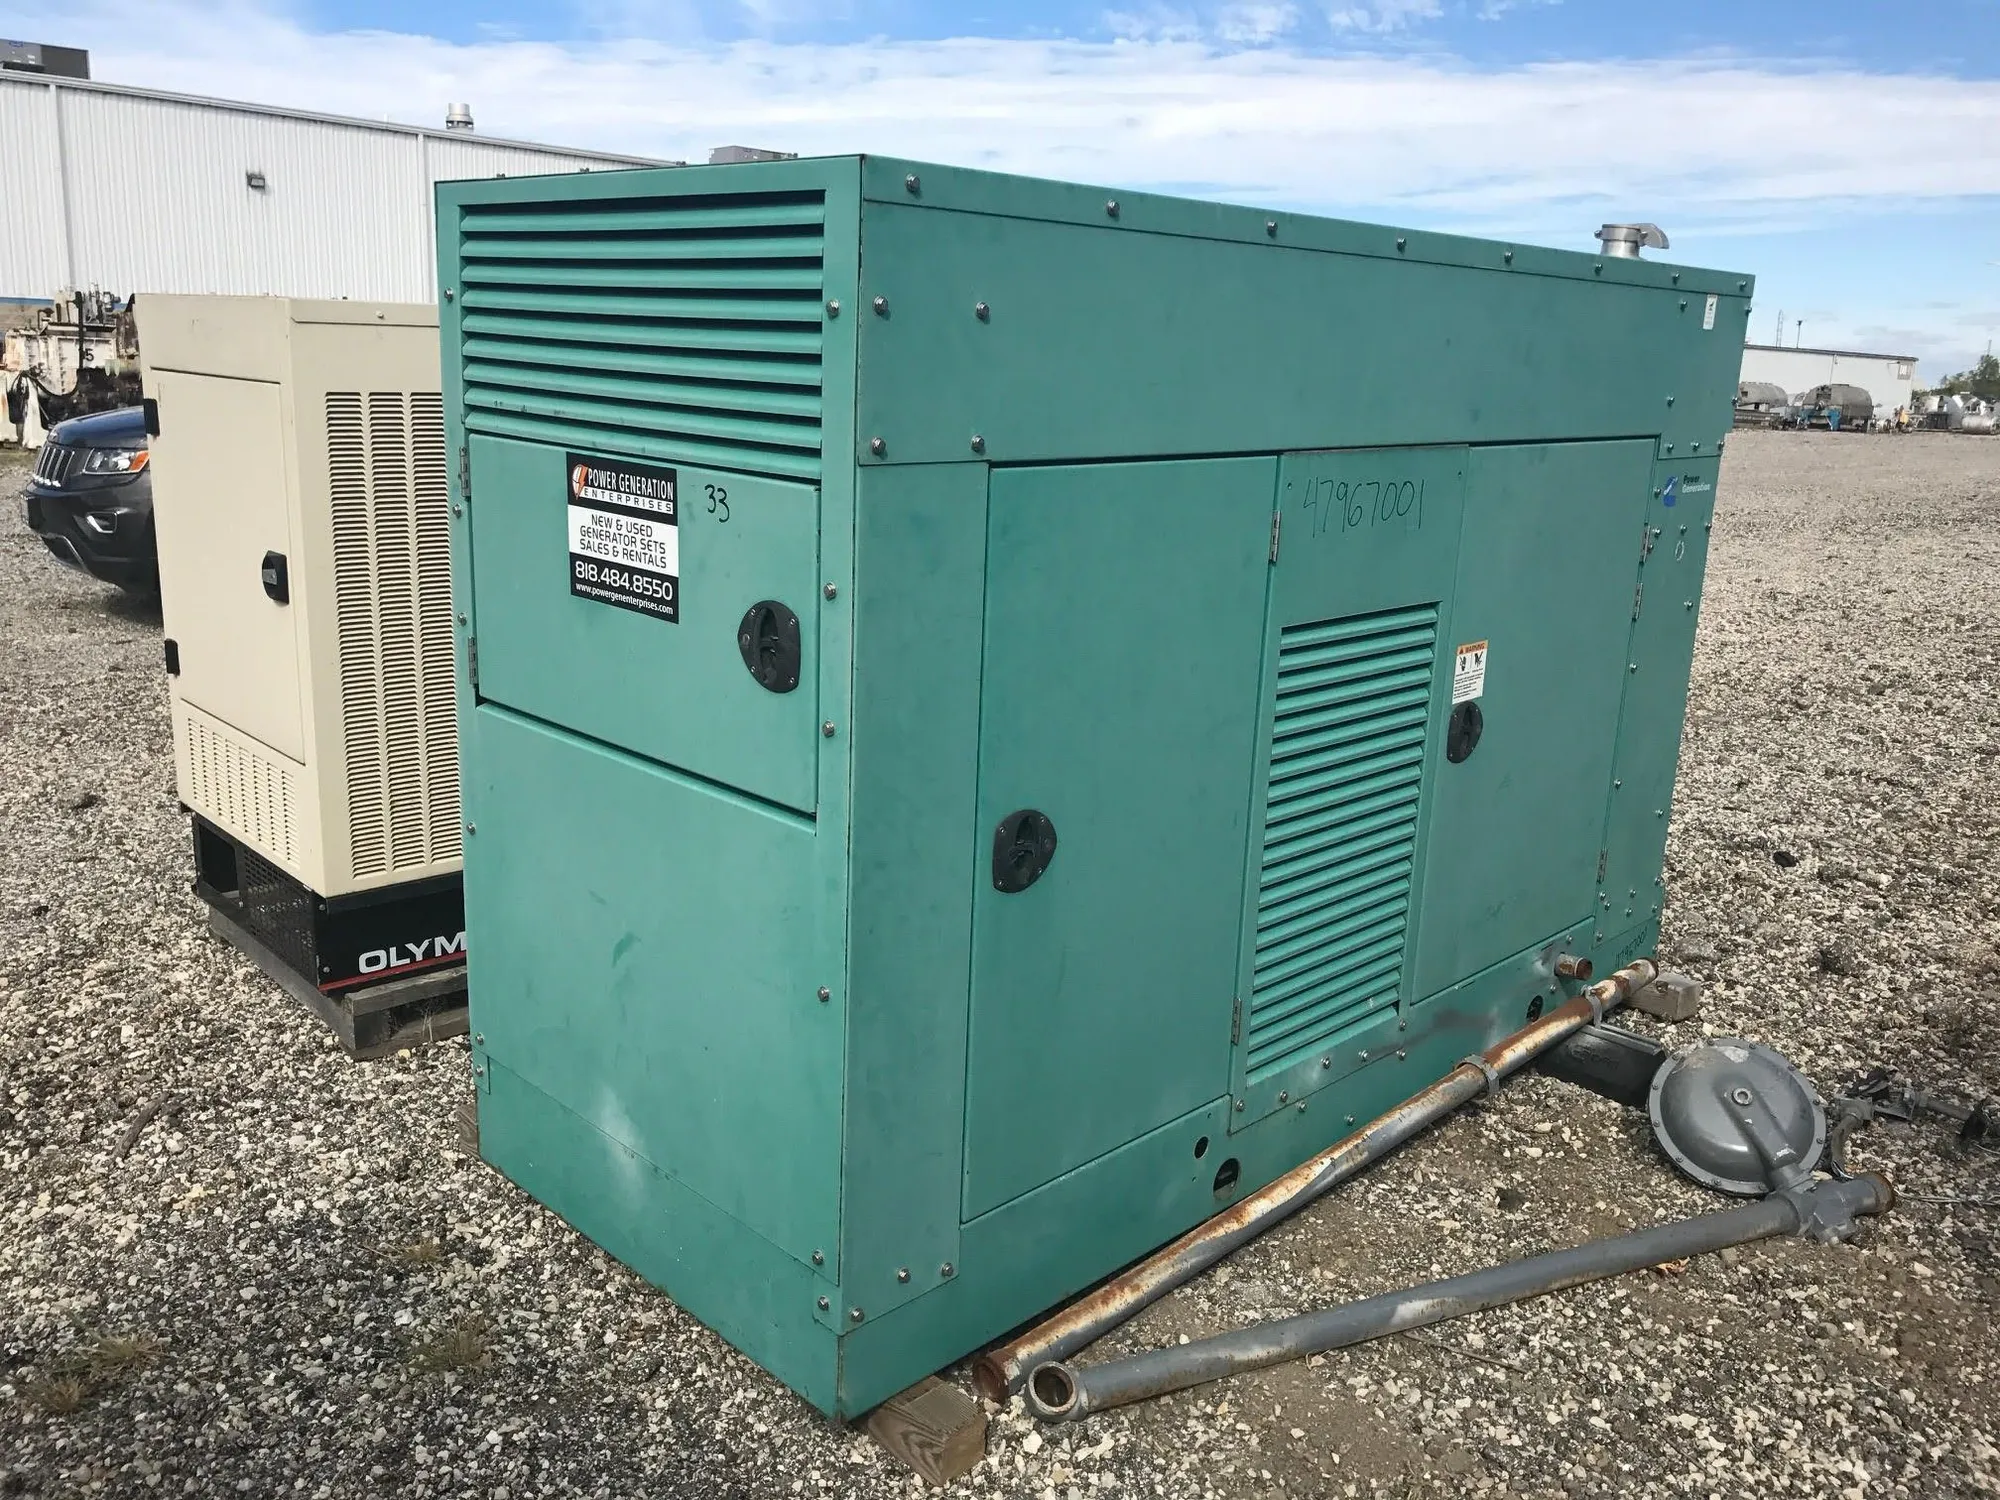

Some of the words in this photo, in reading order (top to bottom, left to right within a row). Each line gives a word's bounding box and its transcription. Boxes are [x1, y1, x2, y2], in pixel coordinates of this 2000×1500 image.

[584, 487, 672, 512] ENTERPRISES
[588, 468, 617, 489] POWER
[618, 474, 674, 500] GENERATION
[704, 484, 730, 523] 33
[1303, 477, 1425, 538] 47967001
[580, 525, 637, 547] GENERATOR
[640, 539, 666, 554] SETS
[591, 514, 614, 529] NEW
[616, 519, 623, 531] &
[626, 522, 653, 537] USED
[580, 538, 610, 556] SALES
[612, 546, 619, 558] &
[622, 548, 667, 569] RENTALS
[575, 560, 673, 601] 818.484.8550
[576, 583, 674, 615] www.powergenenterprises.com
[358, 931, 468, 974] OLYM
